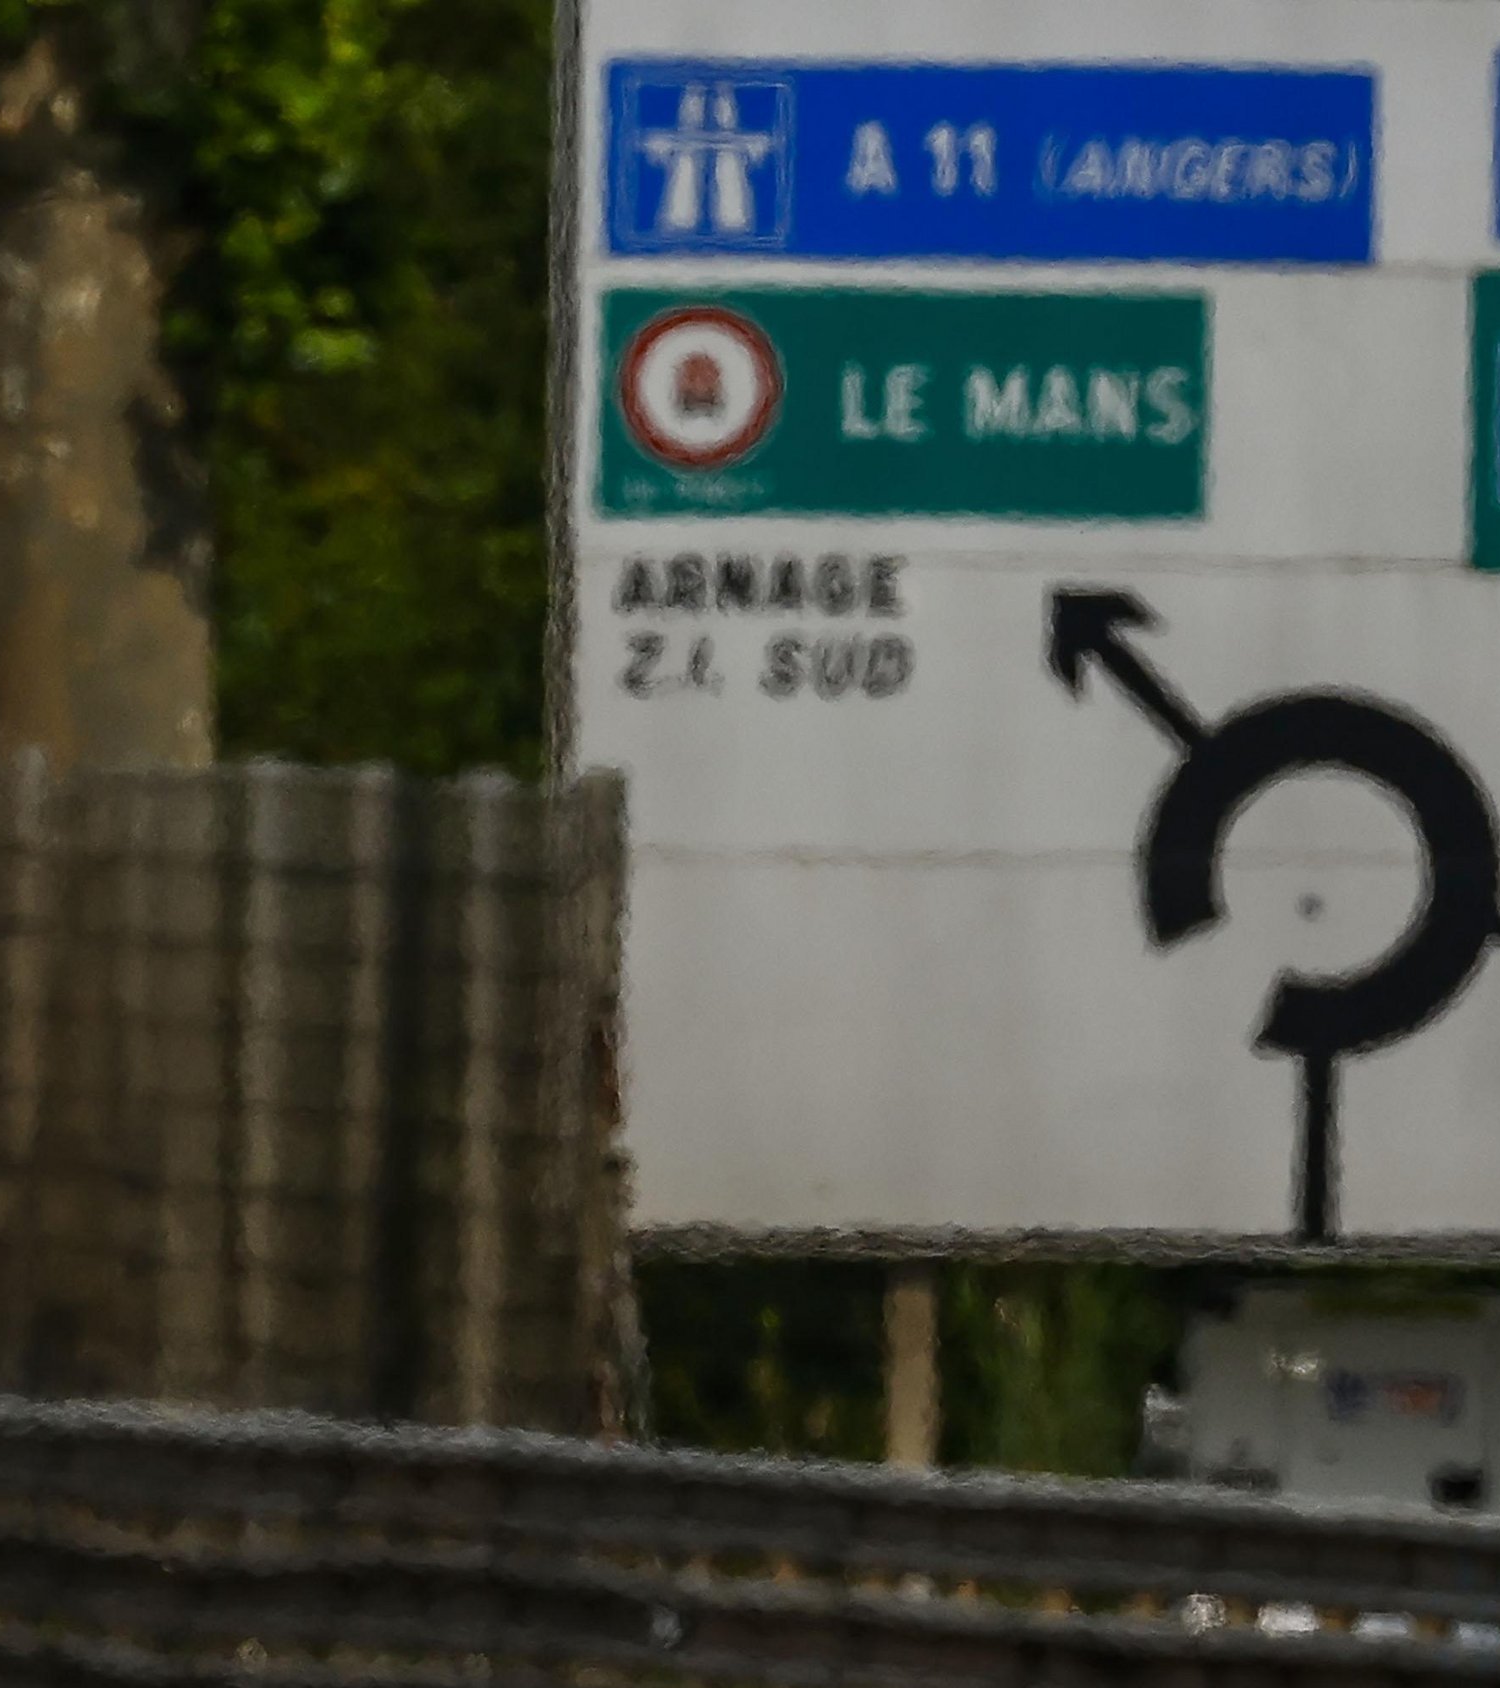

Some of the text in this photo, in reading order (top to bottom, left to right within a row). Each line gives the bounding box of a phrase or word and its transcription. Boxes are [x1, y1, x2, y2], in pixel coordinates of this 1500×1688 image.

[846, 120, 1360, 202] A 11 (ANGERS)
[840, 361, 1195, 446] LE MANS
[612, 553, 908, 617] ARNAGE
[758, 632, 914, 701] SUD
